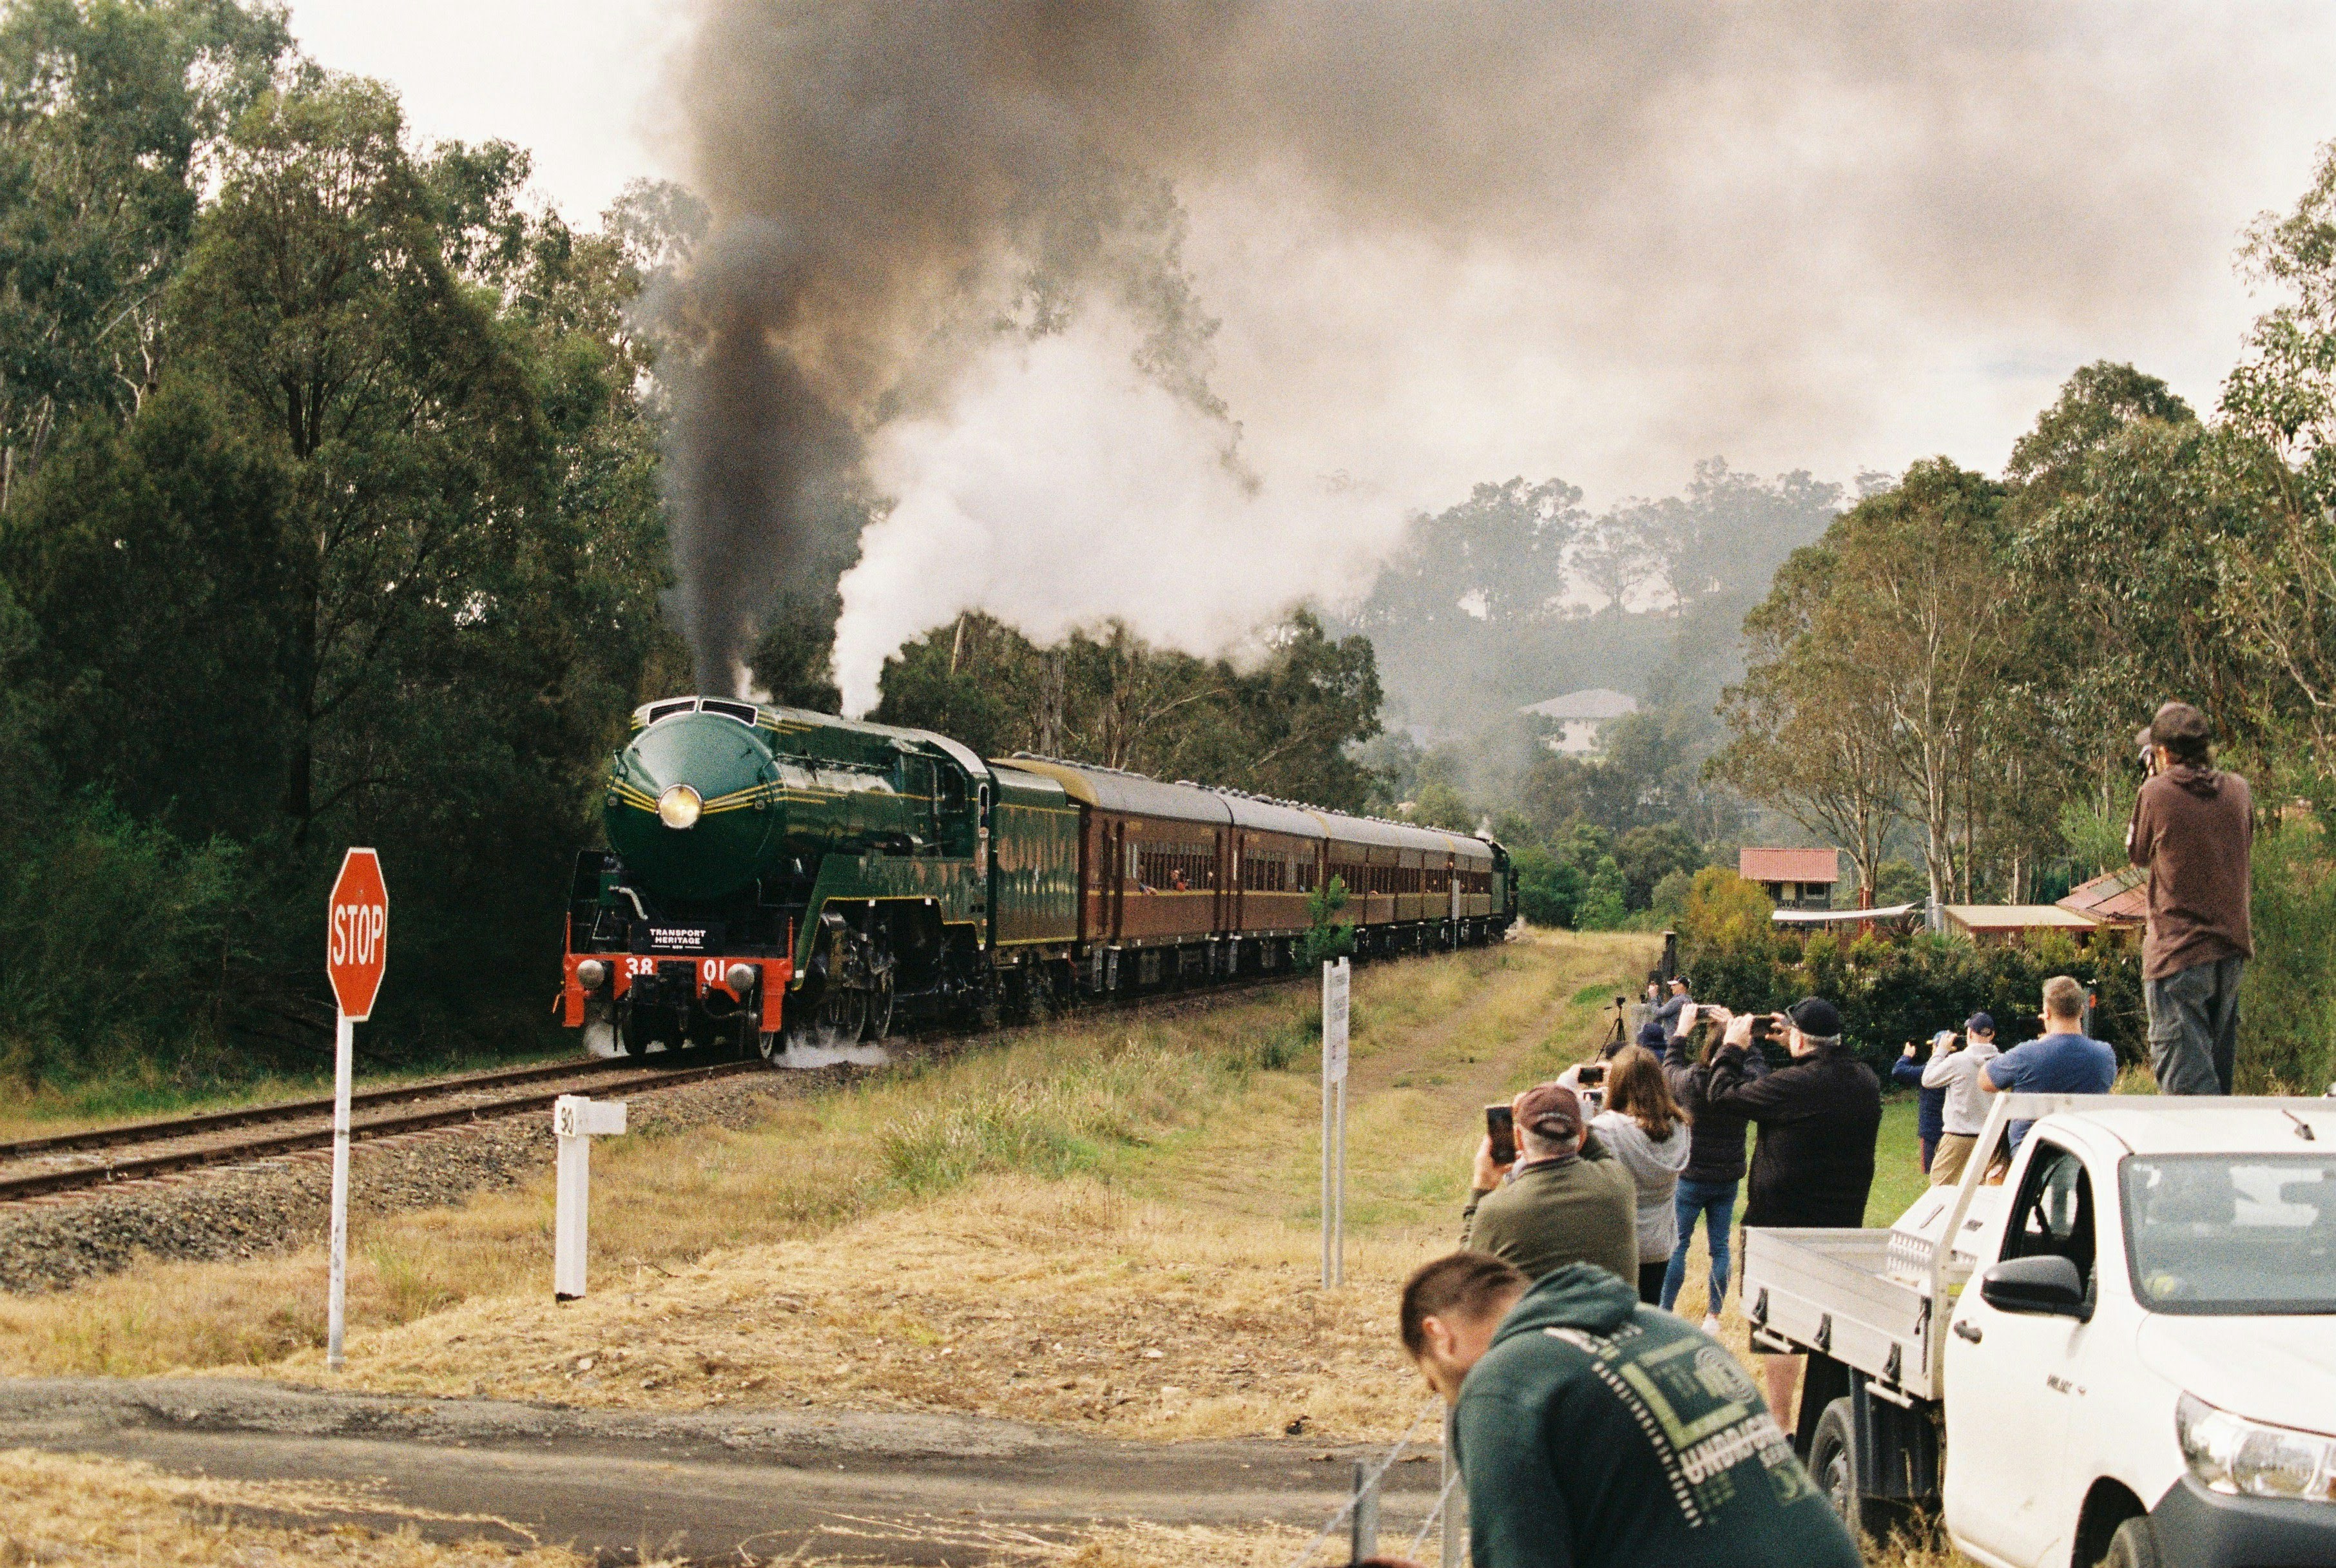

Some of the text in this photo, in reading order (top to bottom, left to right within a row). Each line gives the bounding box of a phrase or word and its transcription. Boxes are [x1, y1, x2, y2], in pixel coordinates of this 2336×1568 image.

[333, 904, 383, 965] STOP
[650, 929, 706, 937] TRANSPORT
[655, 936, 700, 945] HERITAGE
[625, 958, 724, 982] 38 01
